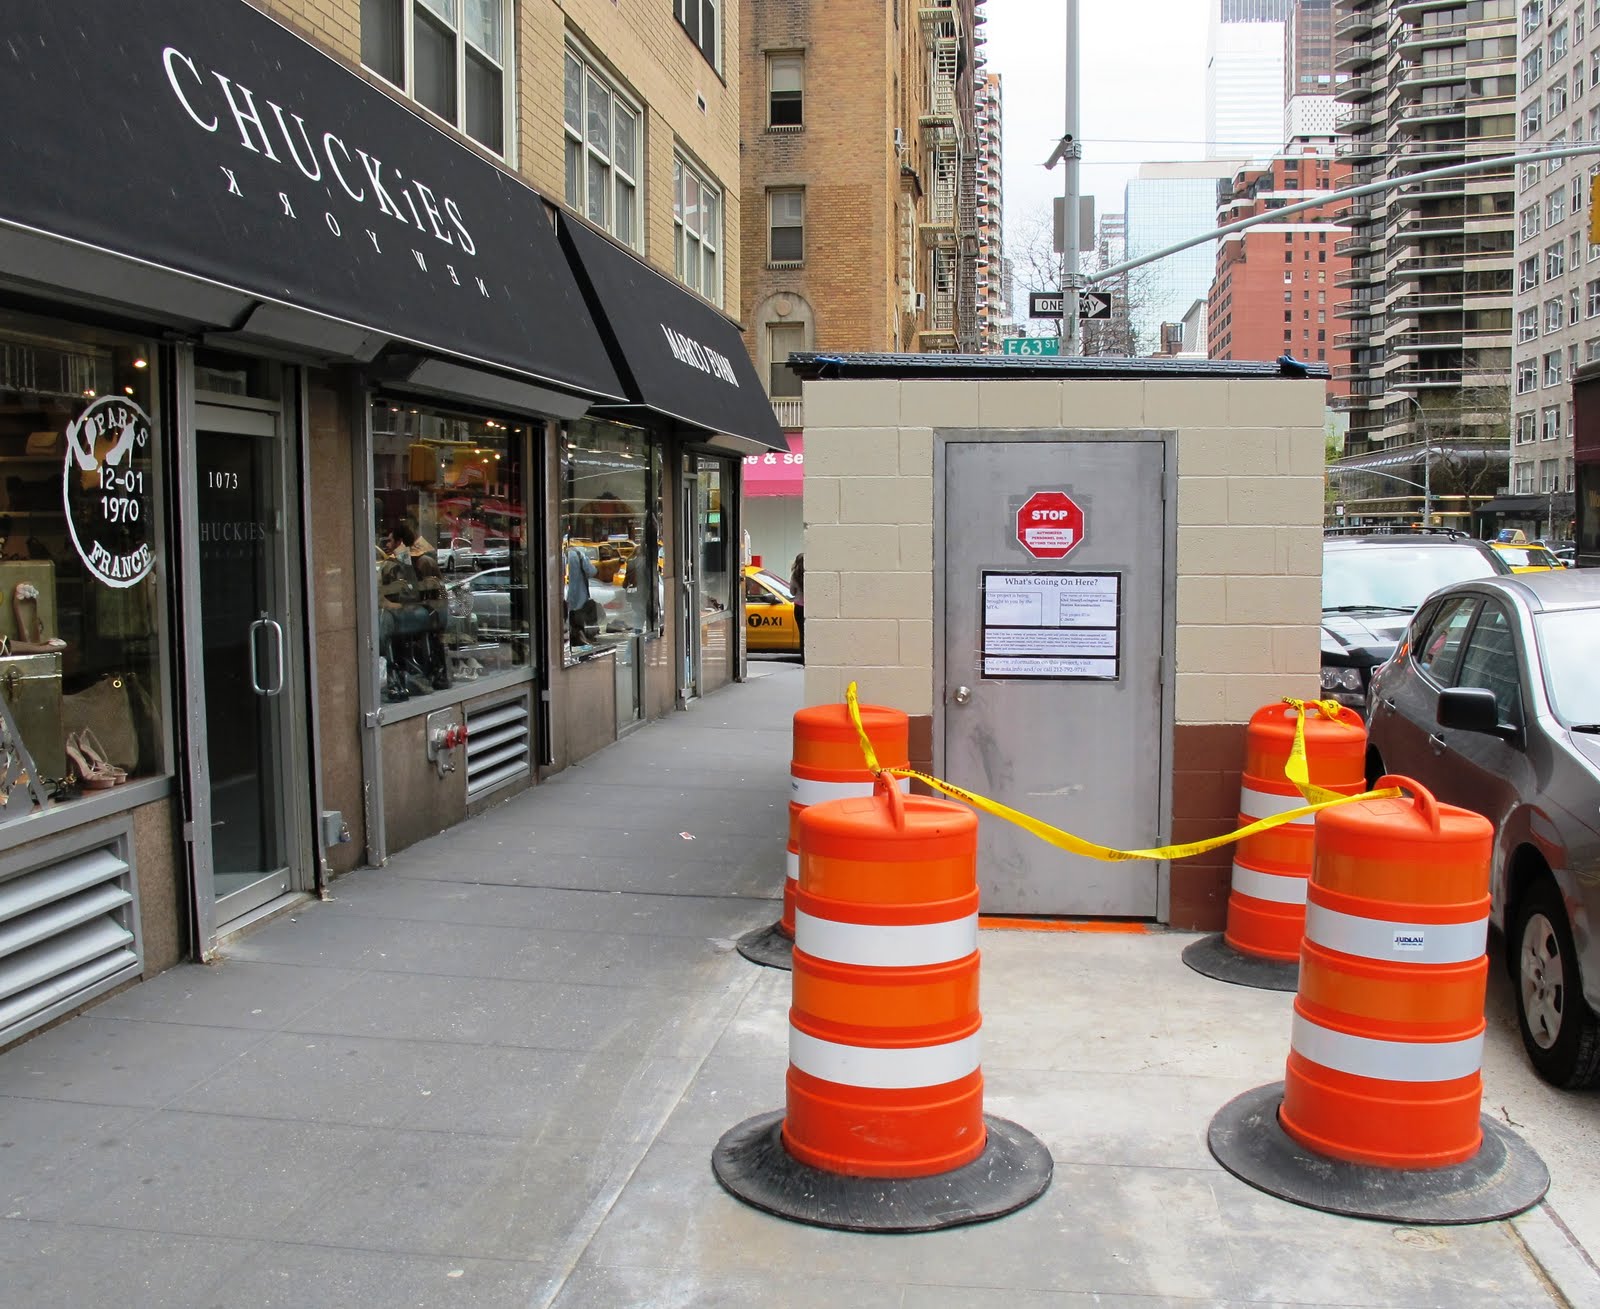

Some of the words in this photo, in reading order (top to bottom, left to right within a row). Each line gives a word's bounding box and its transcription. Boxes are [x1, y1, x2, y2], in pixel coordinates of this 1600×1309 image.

[1041, 300, 1063, 311] ONE
[660, 323, 711, 374] MARCO
[1008, 341, 1018, 355] E
[1020, 340, 1043, 355] 63
[1045, 340, 1057, 349] ST
[94, 407, 149, 447] PARIS
[763, 452, 777, 465] &
[97, 466, 143, 494] 12-01
[208, 471, 239, 489] 1073
[101, 496, 140, 523] 1970
[1031, 510, 1068, 521] STOP
[89, 540, 150, 578] FRANCE
[1004, 577, 1032, 586] What's
[1033, 577, 1059, 587] Going
[1060, 578, 1074, 586] On
[1075, 578, 1099, 586] Here?
[748, 613, 783, 628] TAXI
